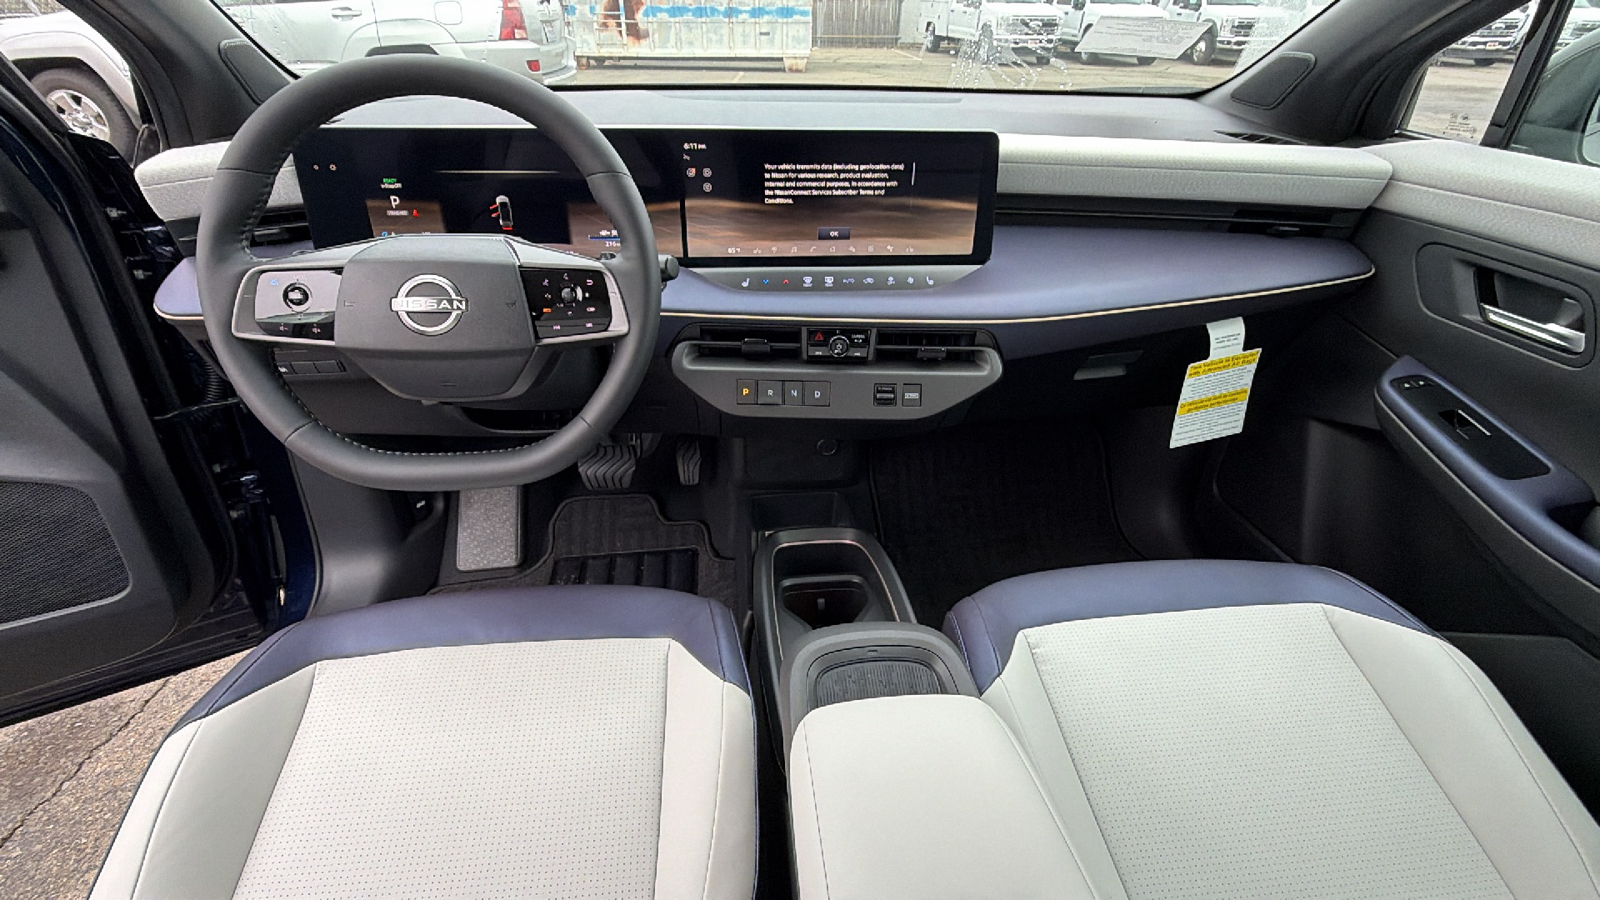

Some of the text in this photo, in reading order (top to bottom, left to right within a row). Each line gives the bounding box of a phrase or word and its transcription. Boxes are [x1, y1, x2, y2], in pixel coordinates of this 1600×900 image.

[390, 195, 400, 209] P
[393, 300, 466, 309] NISSAN
[742, 388, 749, 396] P
